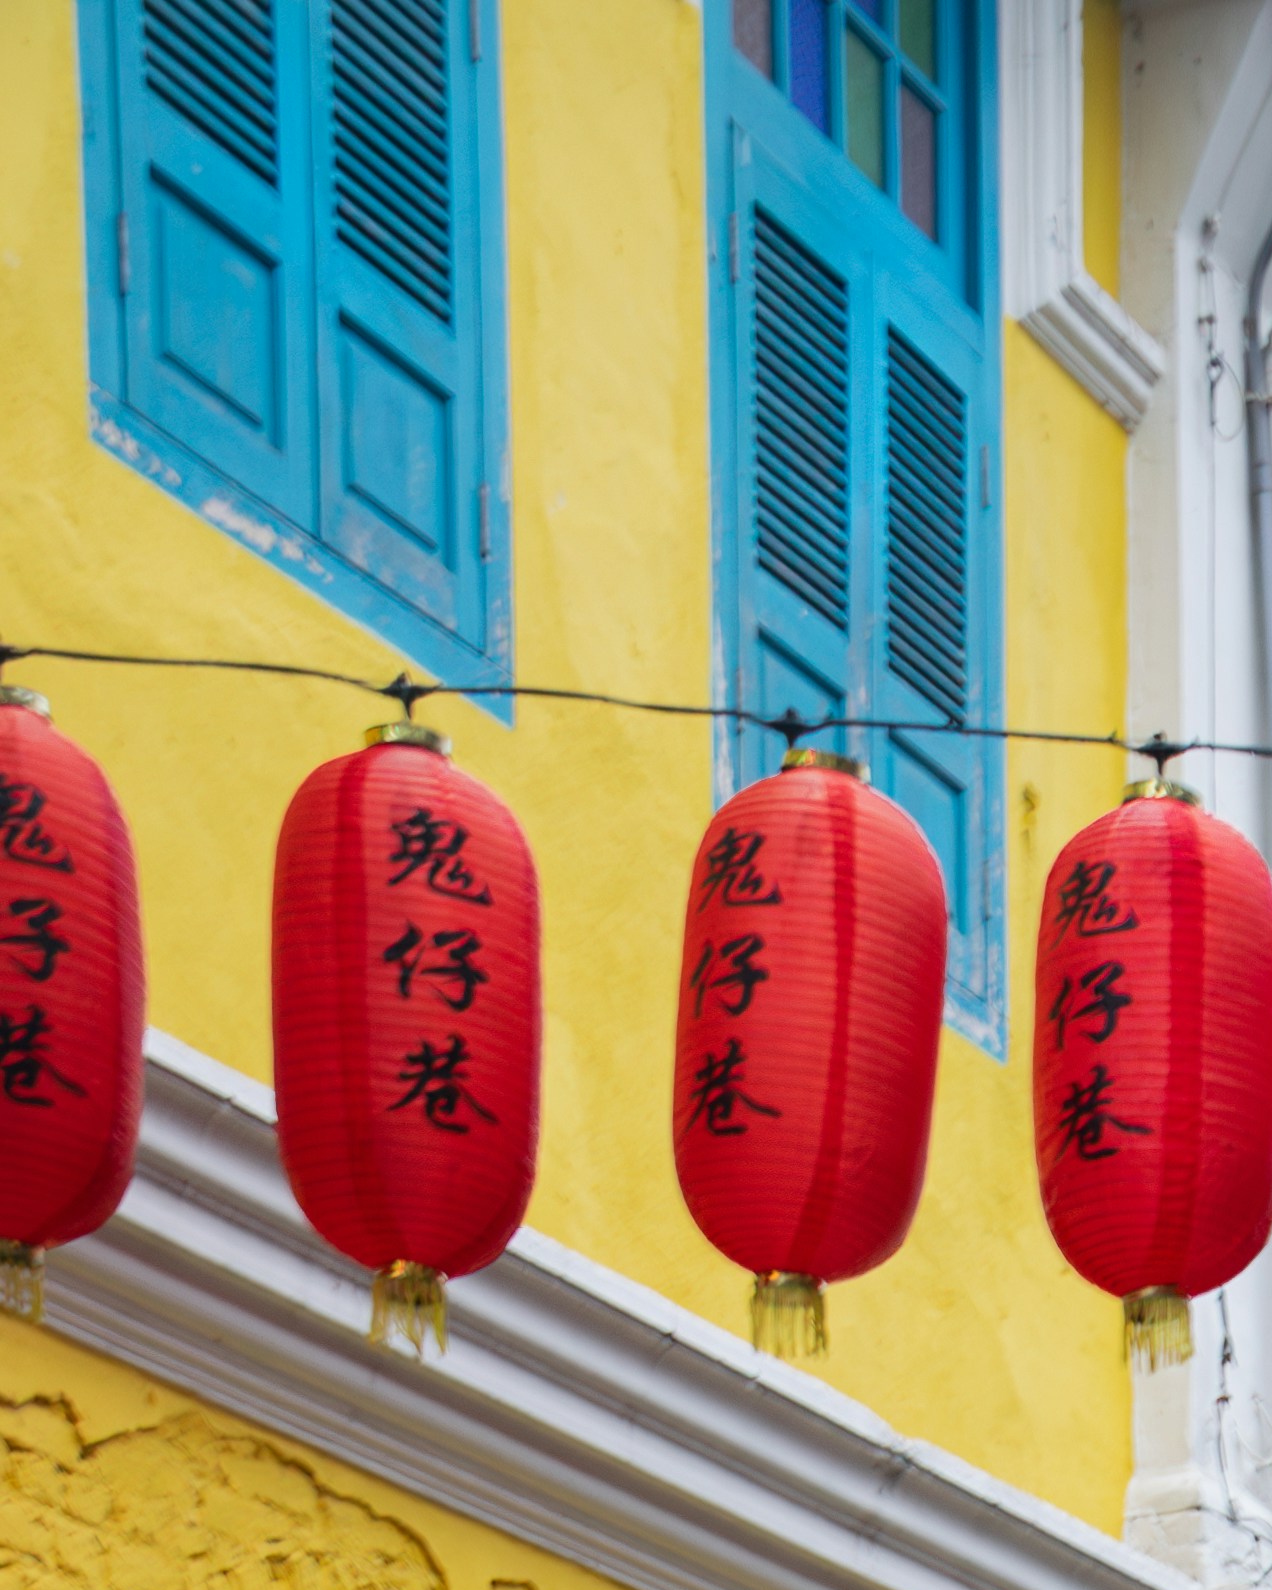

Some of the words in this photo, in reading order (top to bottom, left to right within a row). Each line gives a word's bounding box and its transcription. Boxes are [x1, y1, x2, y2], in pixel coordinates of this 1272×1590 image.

[382, 806, 499, 1135] 鬼仔巷
[690, 826, 784, 1137] 鬼仔巷
[1048, 860, 1153, 1163] 鬼仔巷
